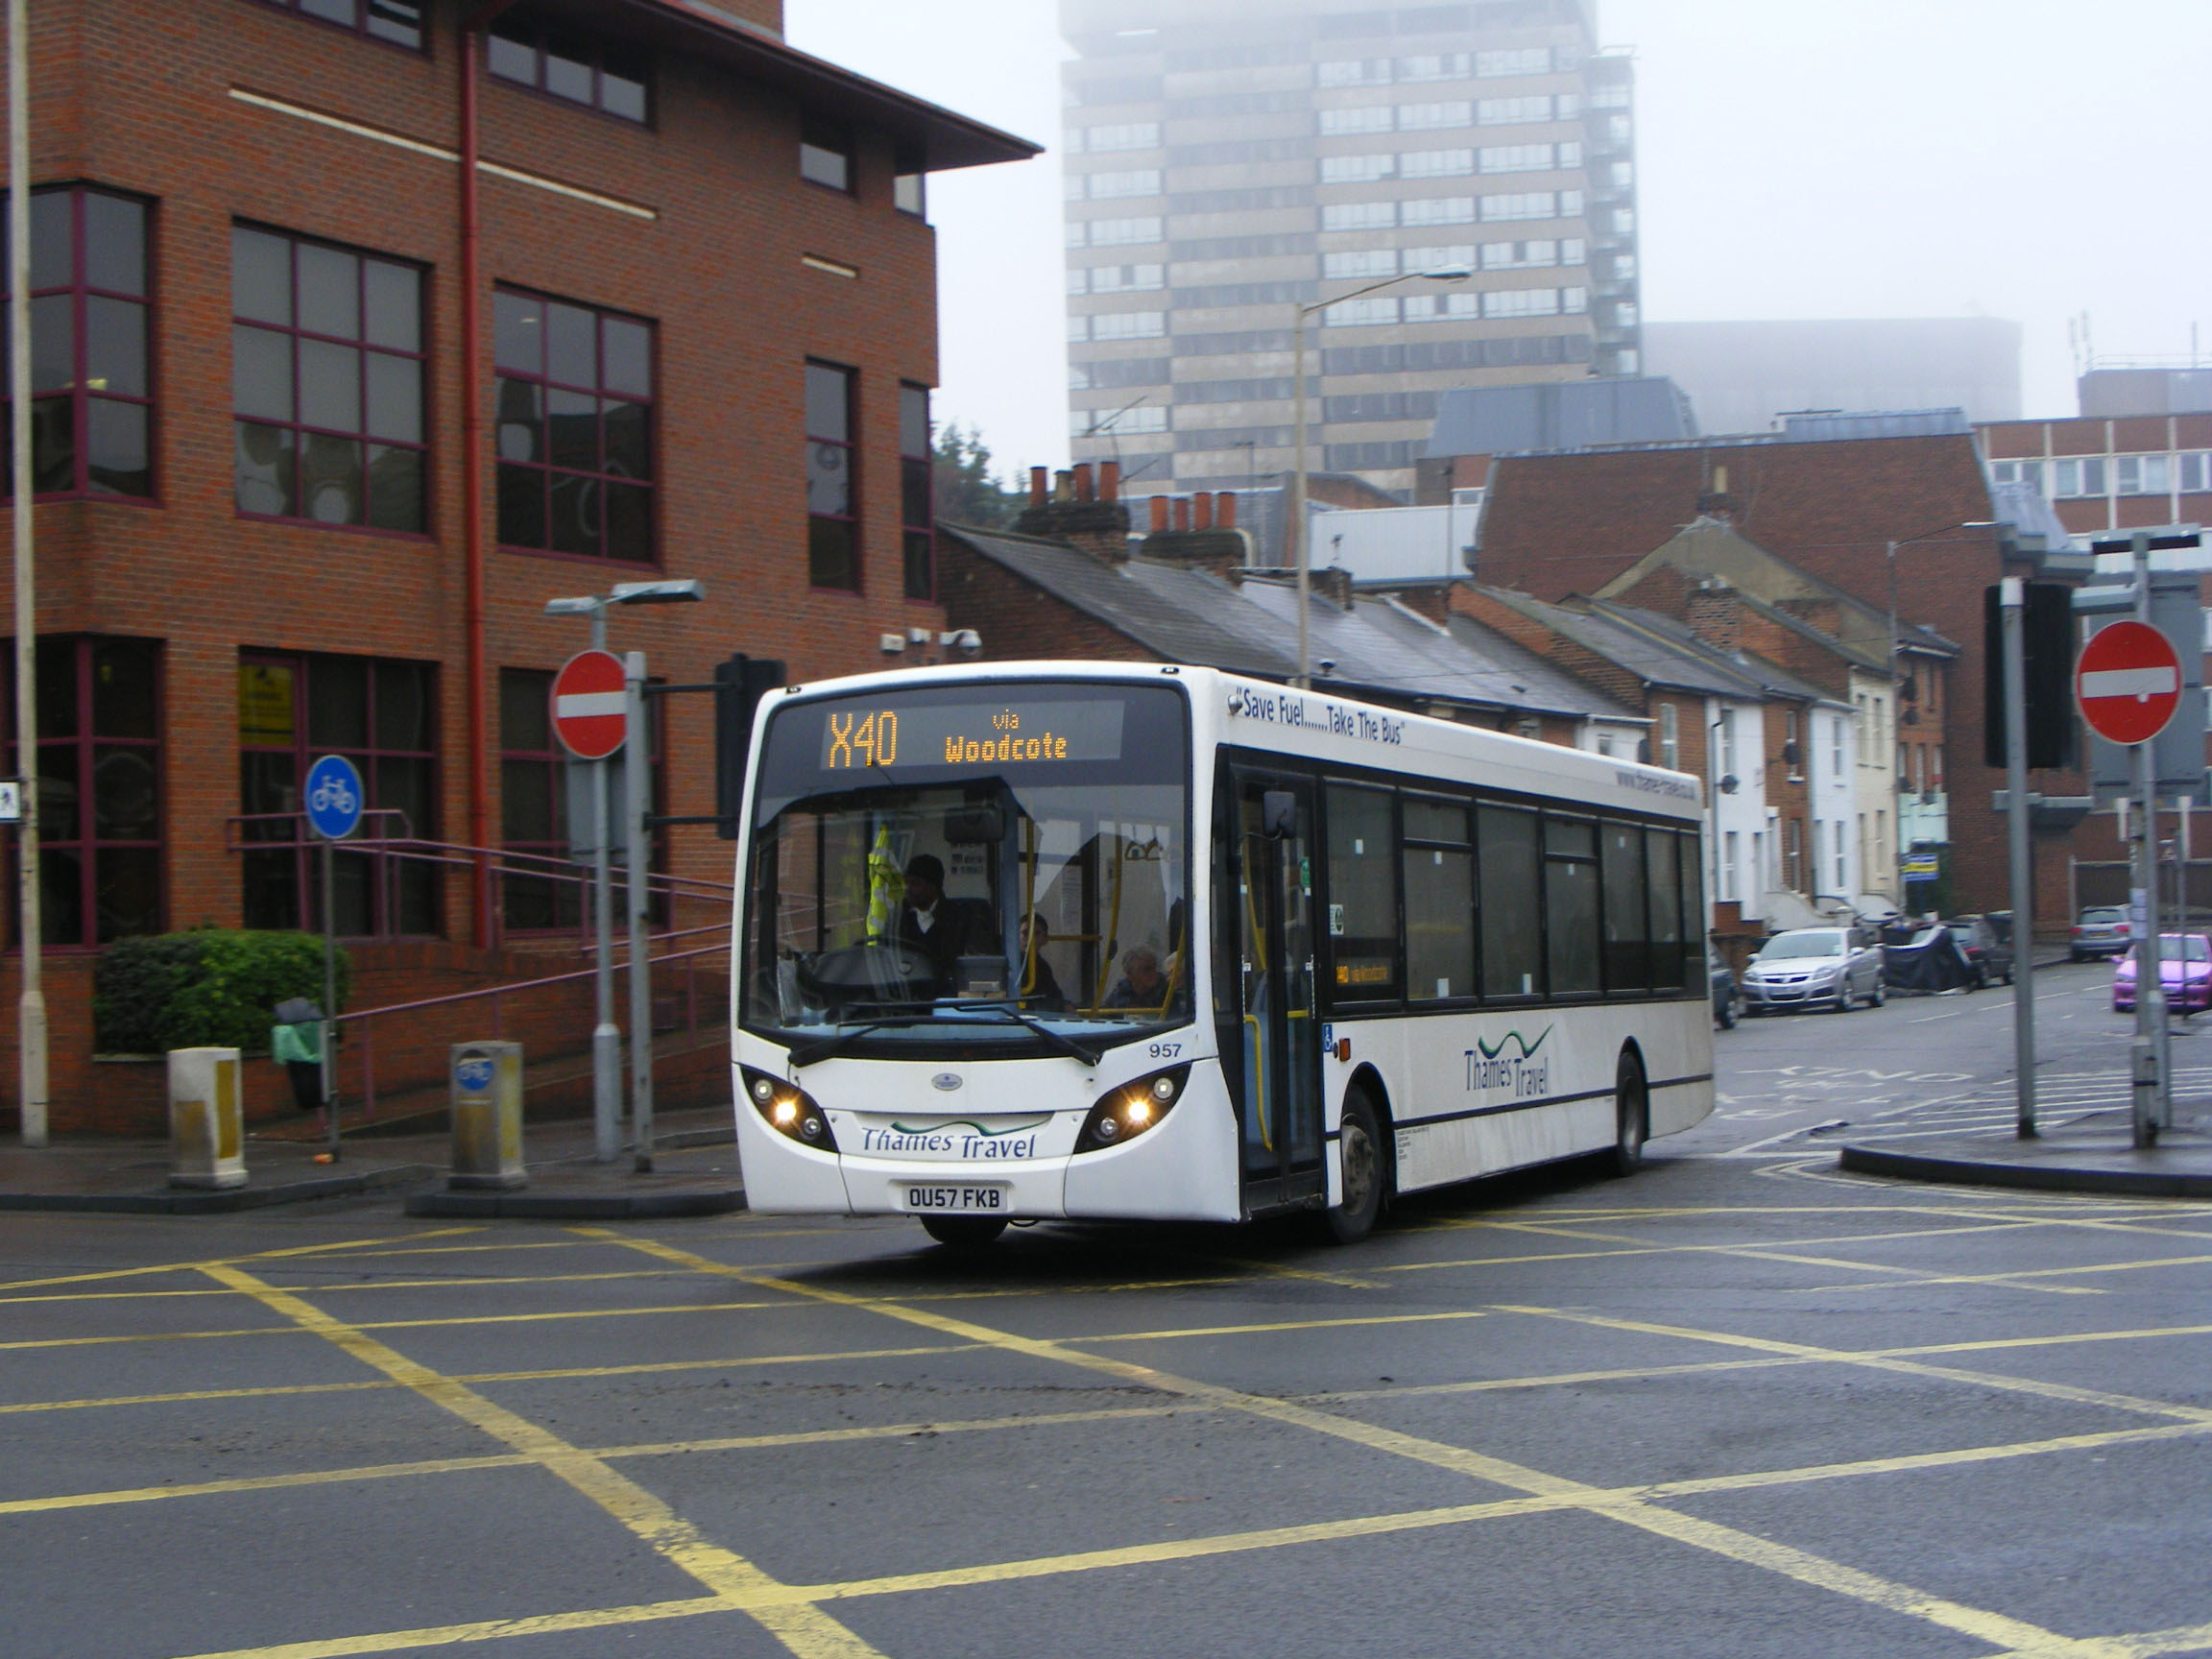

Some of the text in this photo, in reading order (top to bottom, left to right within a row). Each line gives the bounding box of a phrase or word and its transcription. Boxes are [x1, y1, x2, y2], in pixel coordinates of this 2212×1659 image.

[993, 709, 1020, 730] via
[1358, 711, 1378, 741] The
[830, 711, 897, 768] X40
[945, 733, 1067, 762] Woodcote
[1149, 1044, 1182, 1058] 957
[1464, 1049, 1548, 1096] Thames Travel
[862, 1127, 1036, 1158] Thames Travel
[909, 1189, 1000, 1208] OU57 FKB
